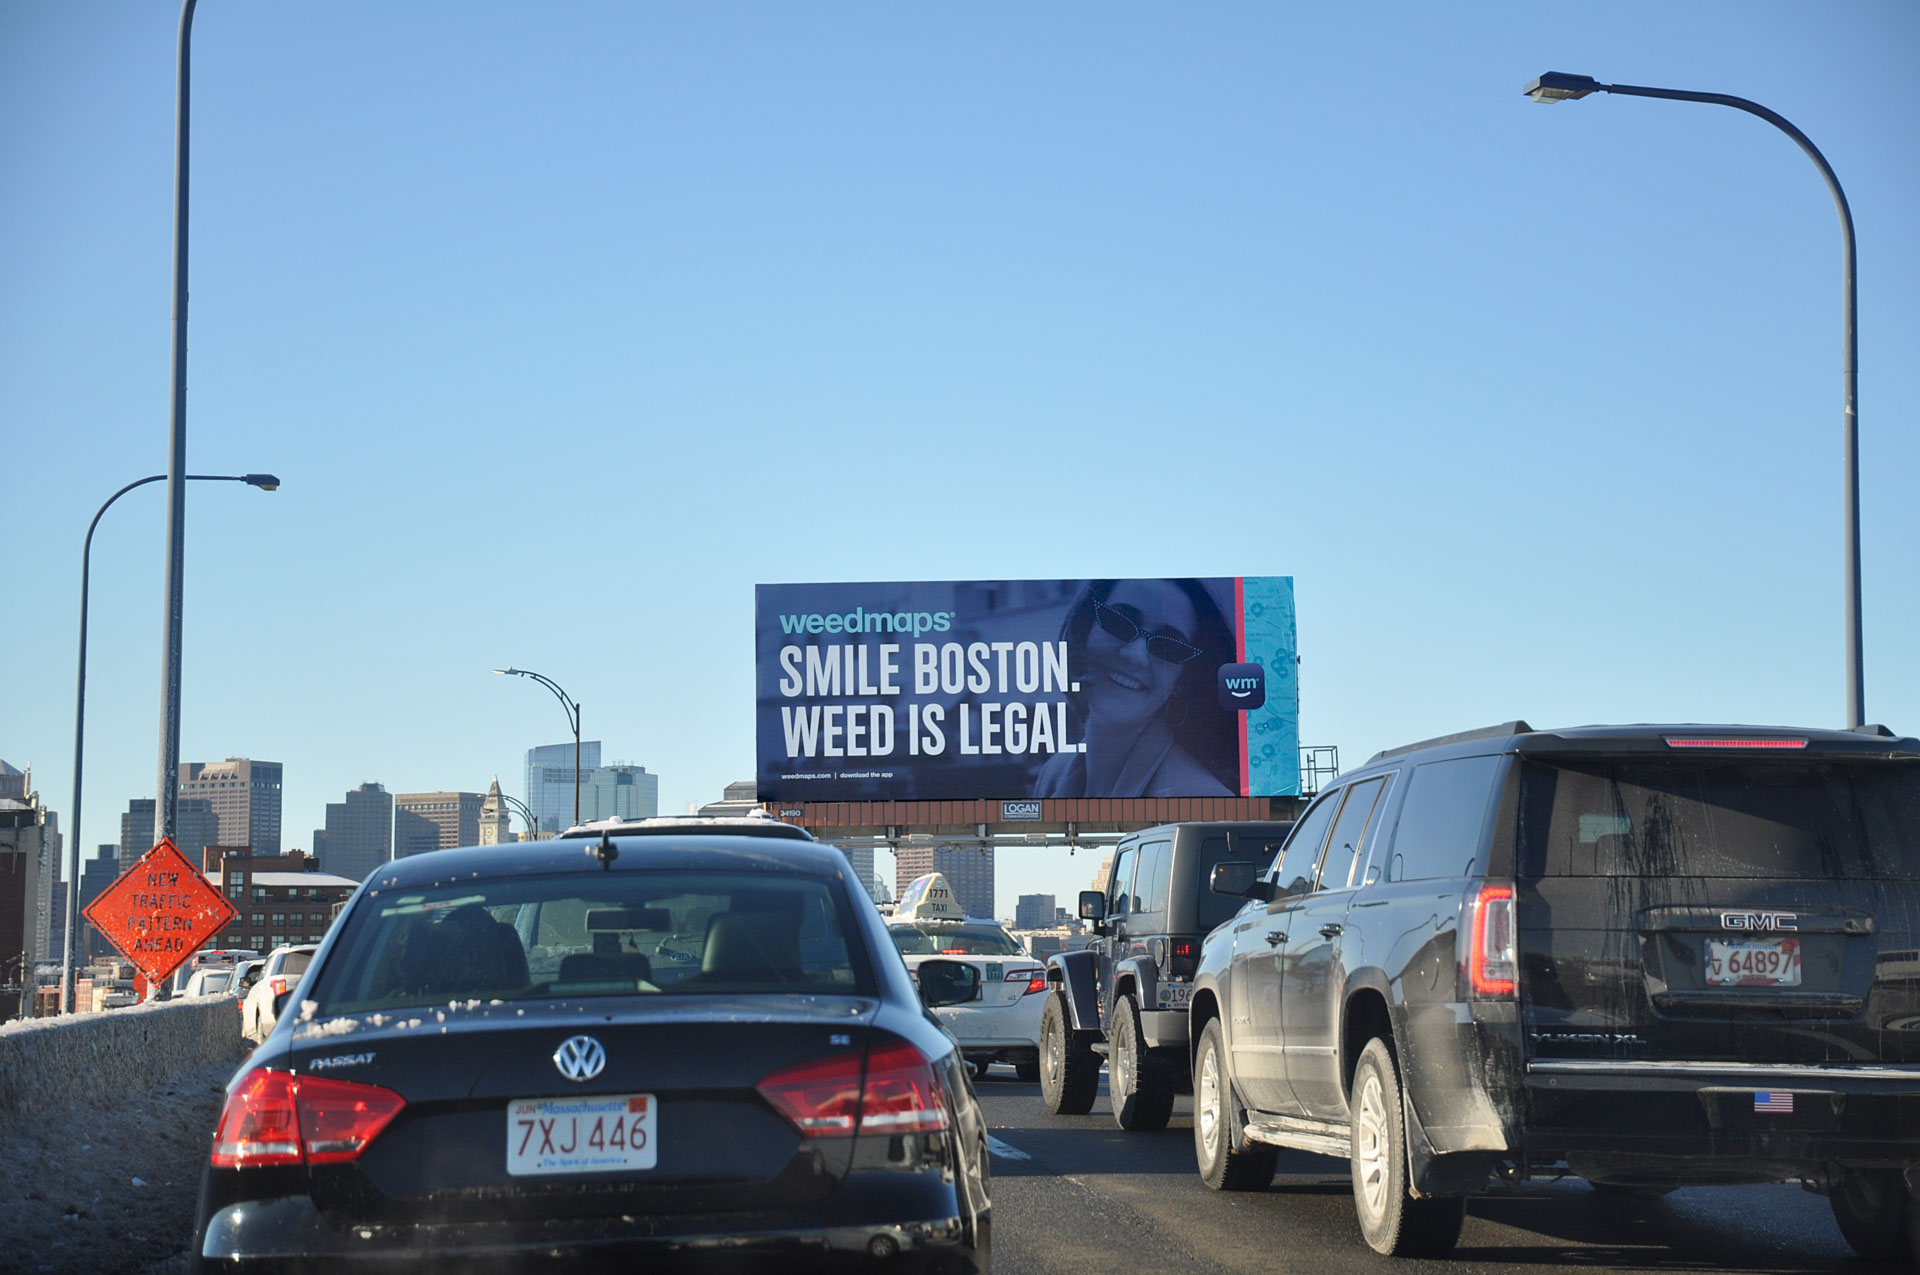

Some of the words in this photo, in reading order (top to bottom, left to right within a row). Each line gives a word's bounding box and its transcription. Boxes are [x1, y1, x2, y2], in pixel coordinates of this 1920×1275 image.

[779, 644, 900, 697] SMILE
[914, 641, 1080, 695] BOSTON.
[781, 703, 895, 758] WEED
[909, 703, 946, 756] IS
[959, 702, 1087, 755] LEGAL.
[781, 772, 832, 780] weedmaps.com
[881, 771, 894, 779] app
[1004, 803, 1039, 815] LOGAN
[147, 872, 179, 887] NEW
[131, 893, 192, 909] TRAFFIC
[929, 889, 948, 898] 1771
[932, 903, 948, 913] TAXI
[127, 916, 192, 931] PATTERN
[1720, 912, 1798, 931] GMC
[134, 938, 183, 952] AHEAD
[1728, 951, 1792, 974] 64897
[1530, 1033, 1610, 1043] YUKON
[1613, 1034, 1647, 1044] XL
[309, 1052, 376, 1070] PASSAT
[515, 1104, 537, 1115] JUN
[542, 1102, 623, 1115] Massachusetts
[632, 1102, 646, 1113] 20
[517, 1117, 577, 1157] 7XJ
[588, 1115, 647, 1151] 446
